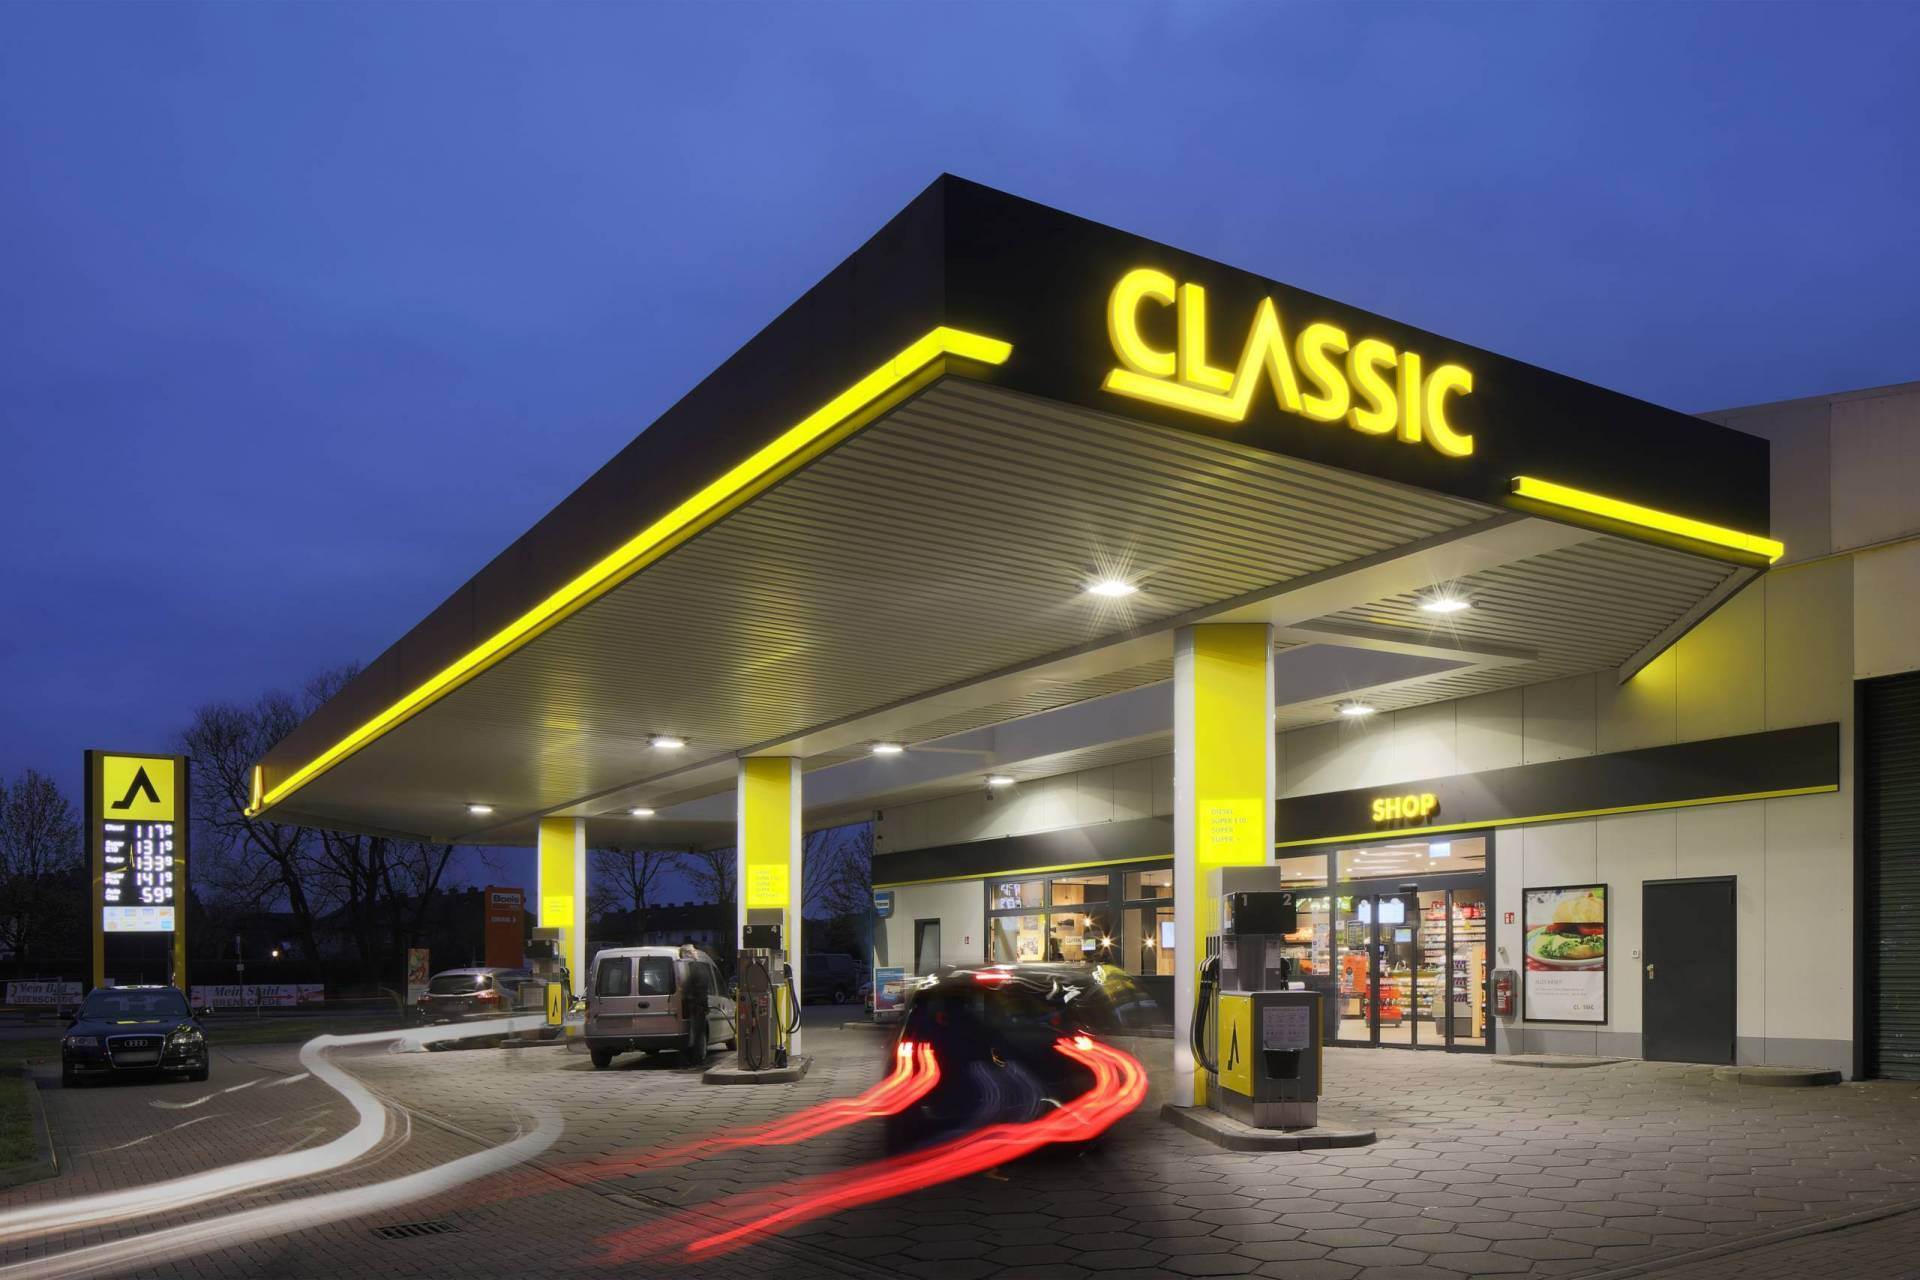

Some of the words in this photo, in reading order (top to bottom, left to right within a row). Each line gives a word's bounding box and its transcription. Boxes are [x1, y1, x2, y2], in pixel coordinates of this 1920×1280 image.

[1101, 268, 1473, 457] CLASSIC
[1372, 793, 1435, 822] SHOP
[1241, 894, 1248, 906] 1
[1282, 893, 1293, 906] 2
[746, 926, 752, 934] 3
